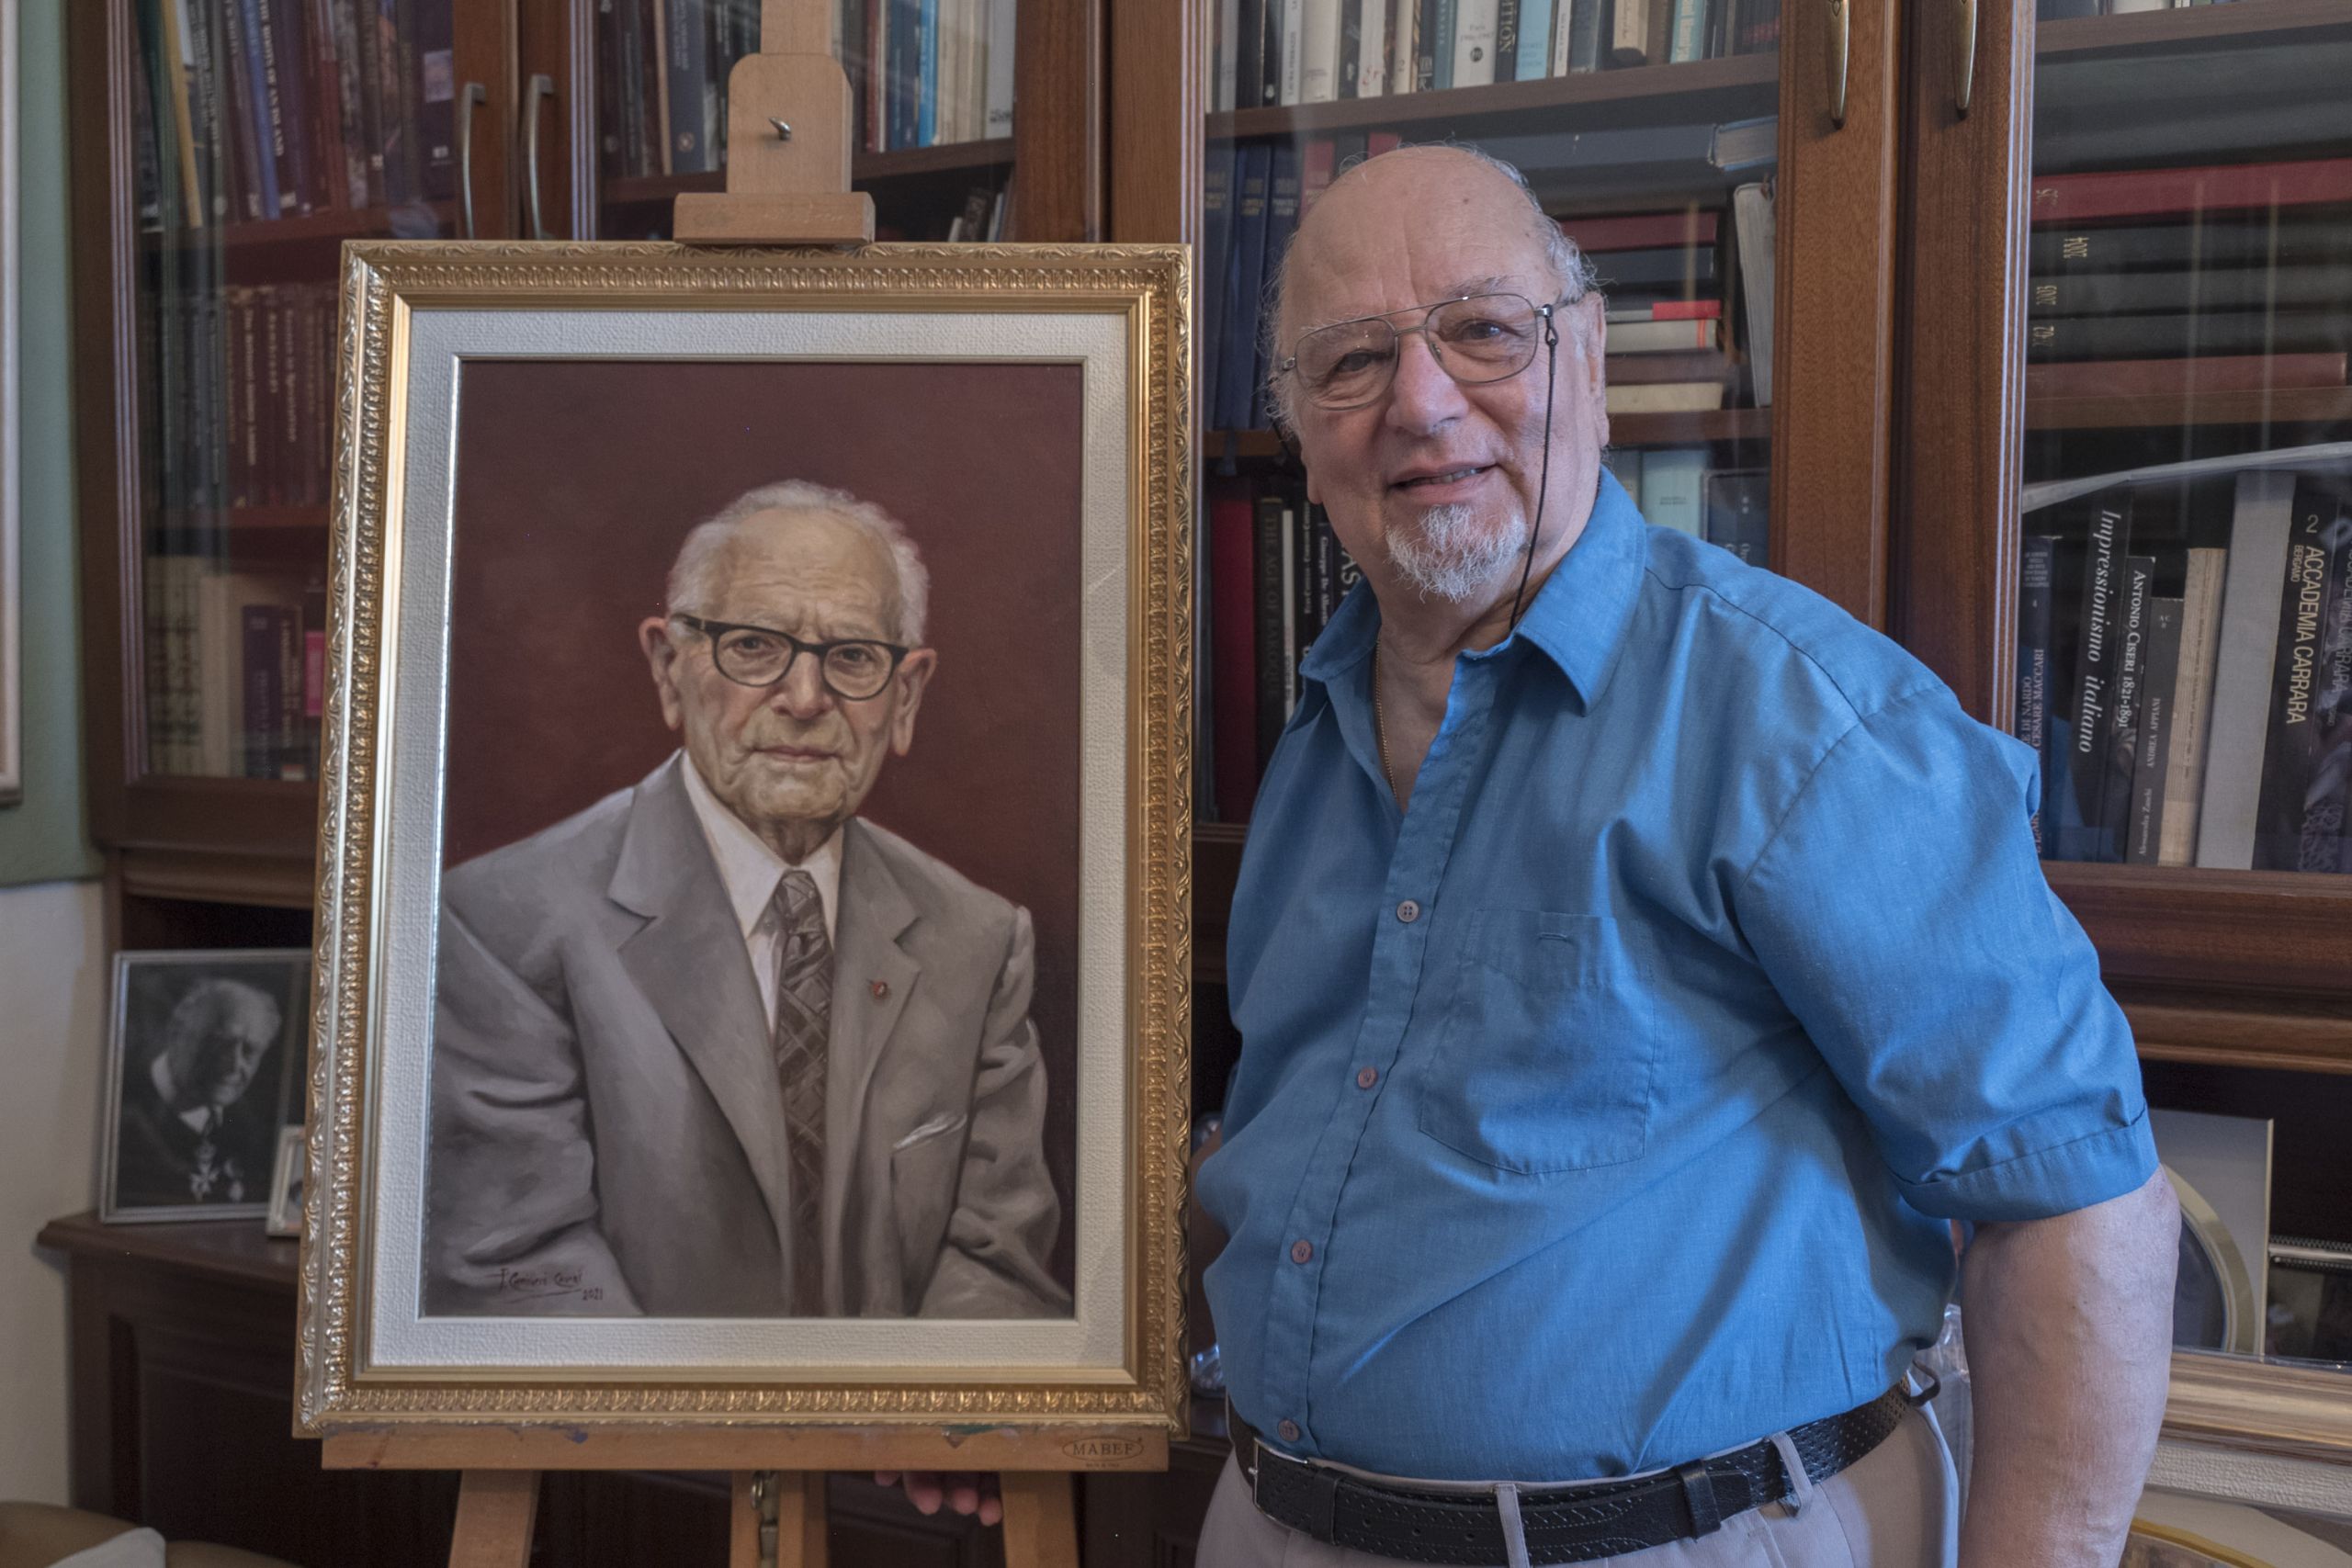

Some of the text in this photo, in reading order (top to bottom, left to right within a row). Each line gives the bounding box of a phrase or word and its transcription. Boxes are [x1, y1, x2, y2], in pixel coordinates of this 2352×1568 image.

[2306, 514, 2318, 534] 2
[2290, 545, 2303, 582] BERGAMO
[2079, 510, 2121, 753] Impressionismo italiano
[2287, 546, 2325, 725] ACCADEMIA CARRARA
[2021, 676, 2031, 721] NARDO
[2031, 649, 2044, 748] CESARE MACCARI
[2118, 675, 2135, 728] 1821-1891
[1073, 1443, 1134, 1455] MABEF
